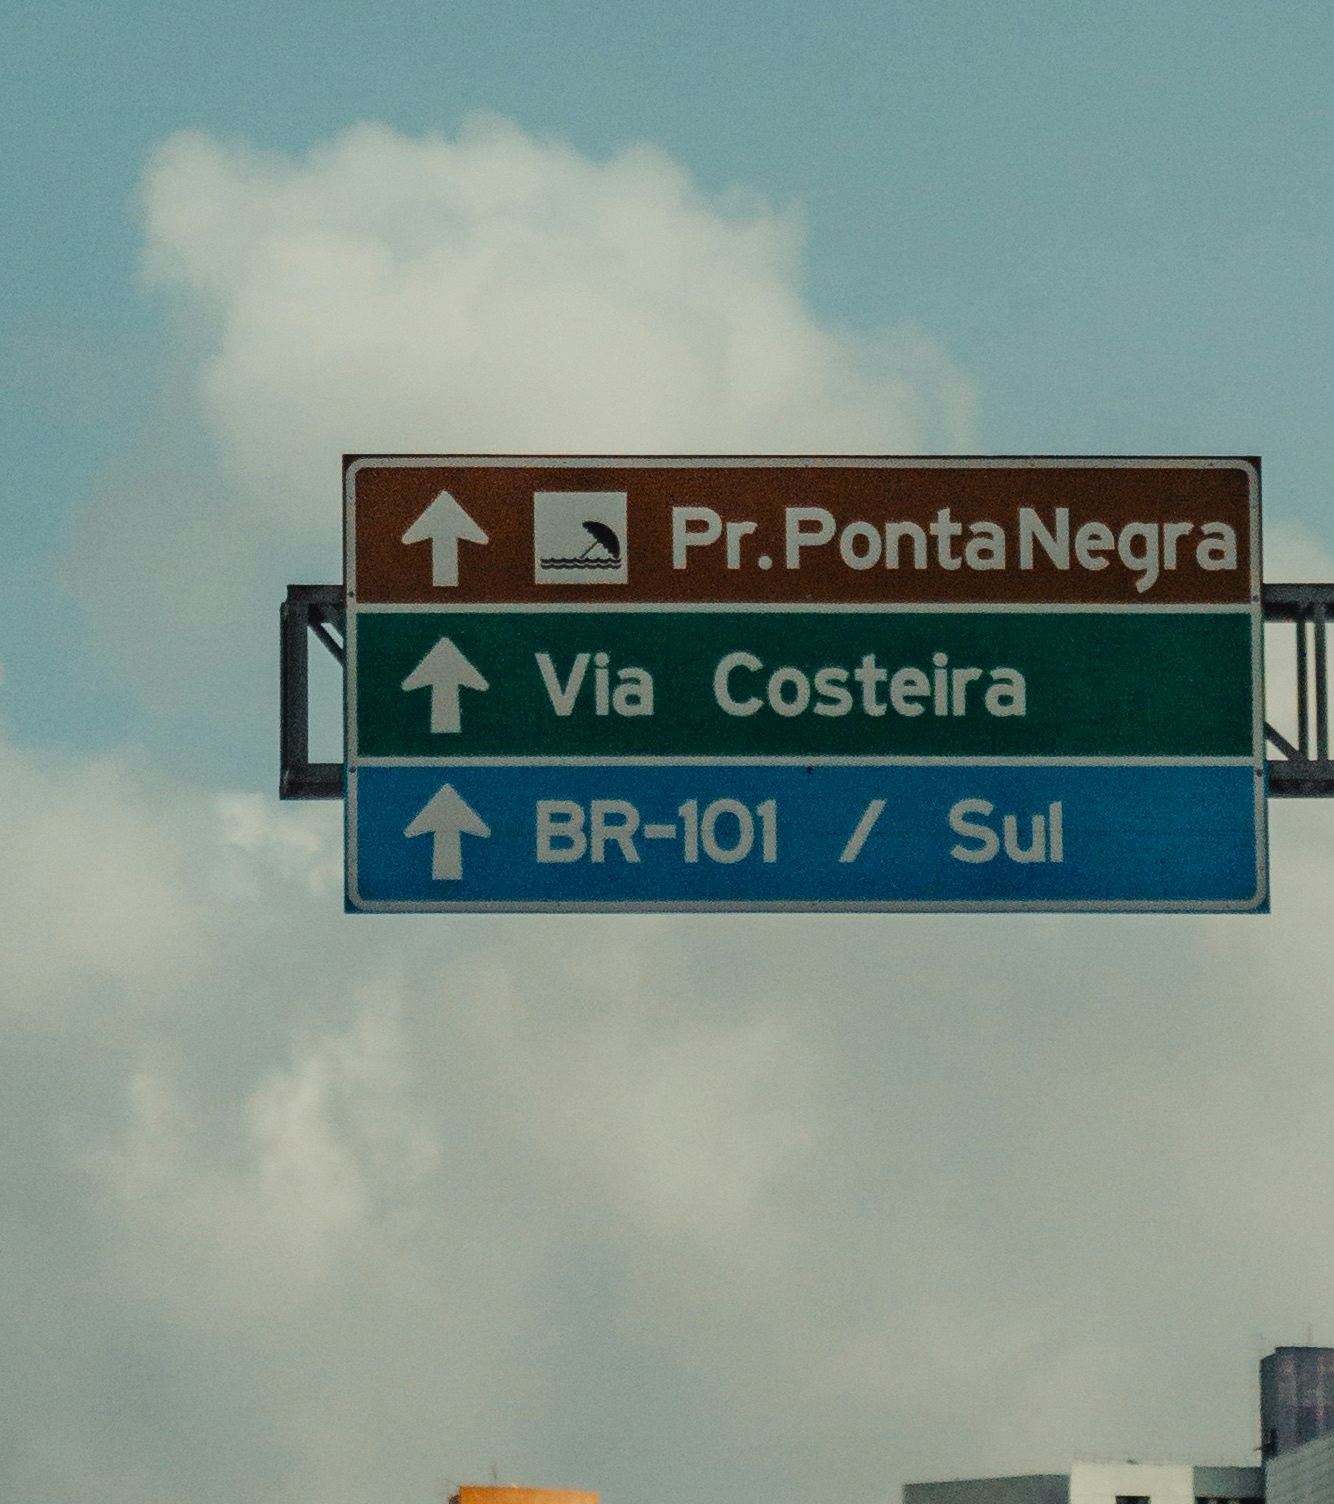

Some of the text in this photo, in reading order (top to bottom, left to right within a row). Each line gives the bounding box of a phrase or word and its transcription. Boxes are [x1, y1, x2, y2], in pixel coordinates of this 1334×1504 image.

[784, 505, 1007, 571] Ponta
[1017, 505, 1238, 593] Negra
[535, 651, 1027, 717] Via Costeira
[536, 798, 778, 864] BR-101
[948, 798, 1064, 864] Sul
